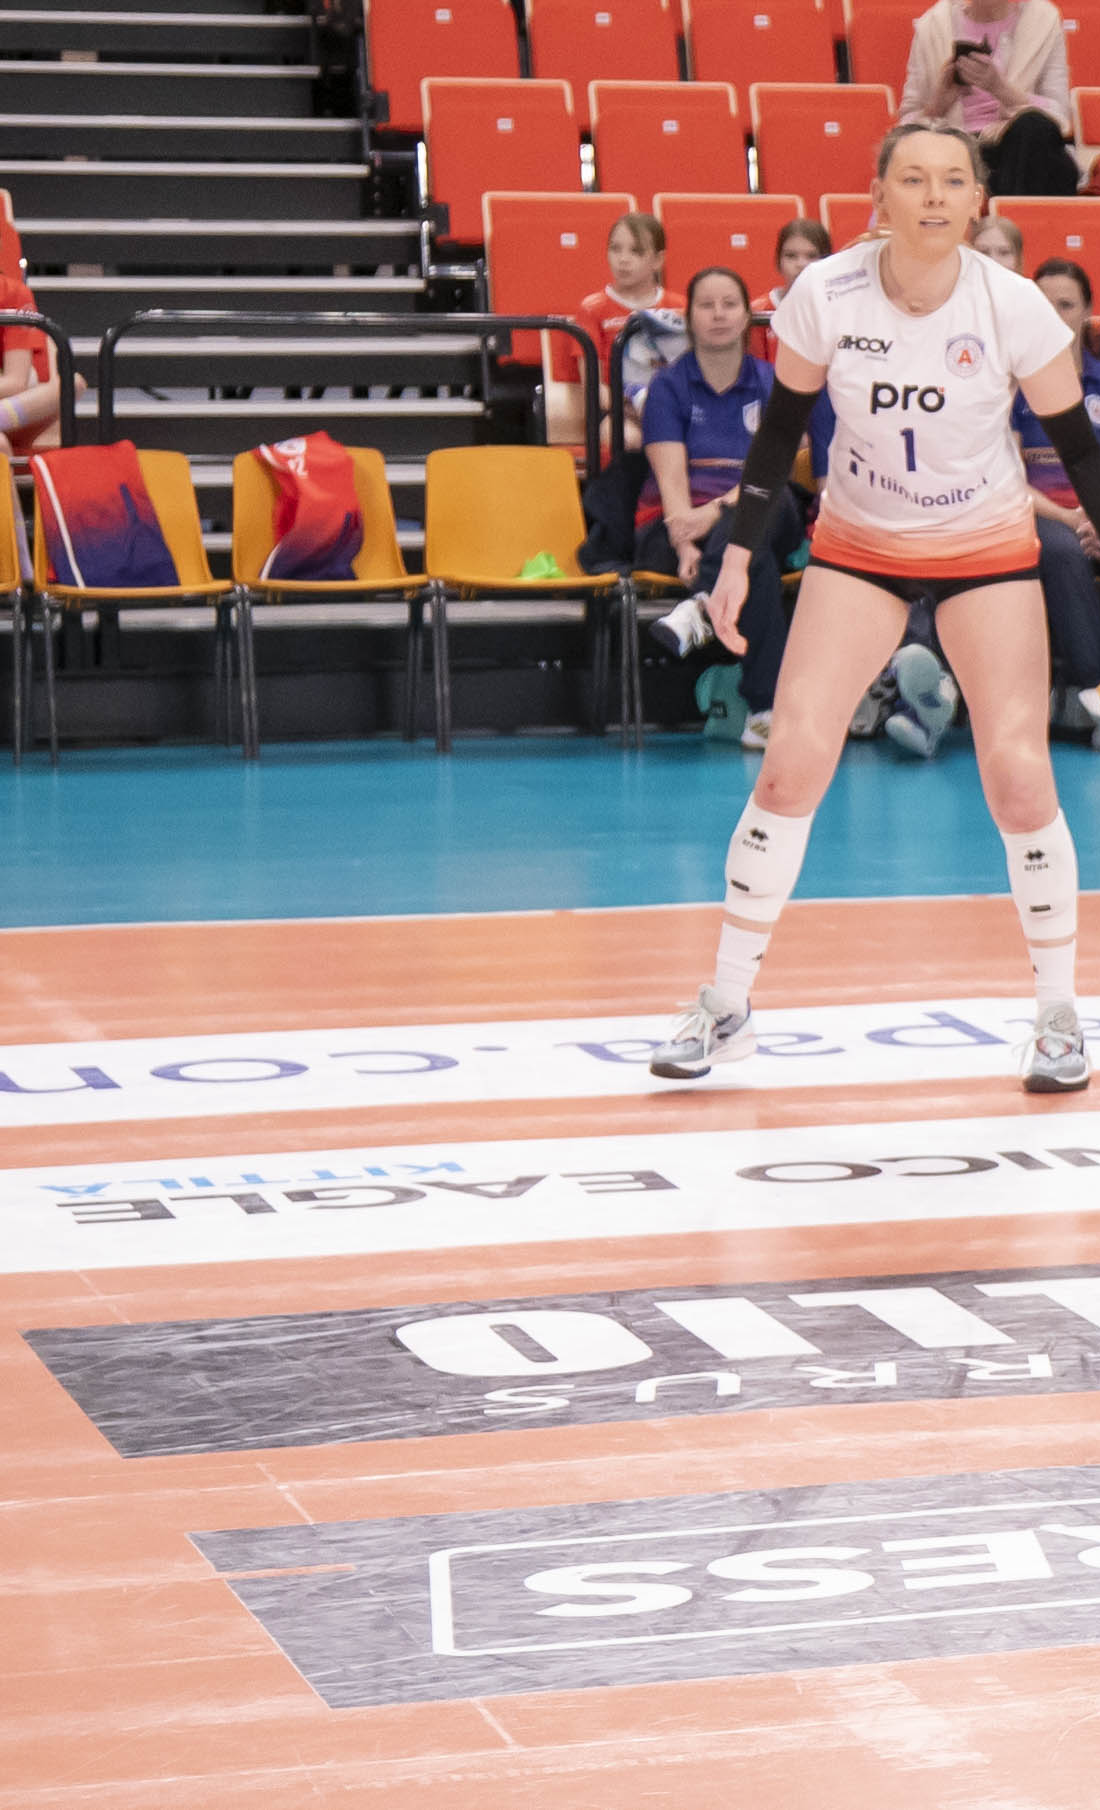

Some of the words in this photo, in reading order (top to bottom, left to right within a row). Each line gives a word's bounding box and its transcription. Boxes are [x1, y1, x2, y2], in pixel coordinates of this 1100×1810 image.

[870, 381, 945, 415] pro
[900, 427, 917, 472] 1
[38, 1161, 467, 1199] KITTILÄ
[56, 1169, 680, 1225] EAGLE
